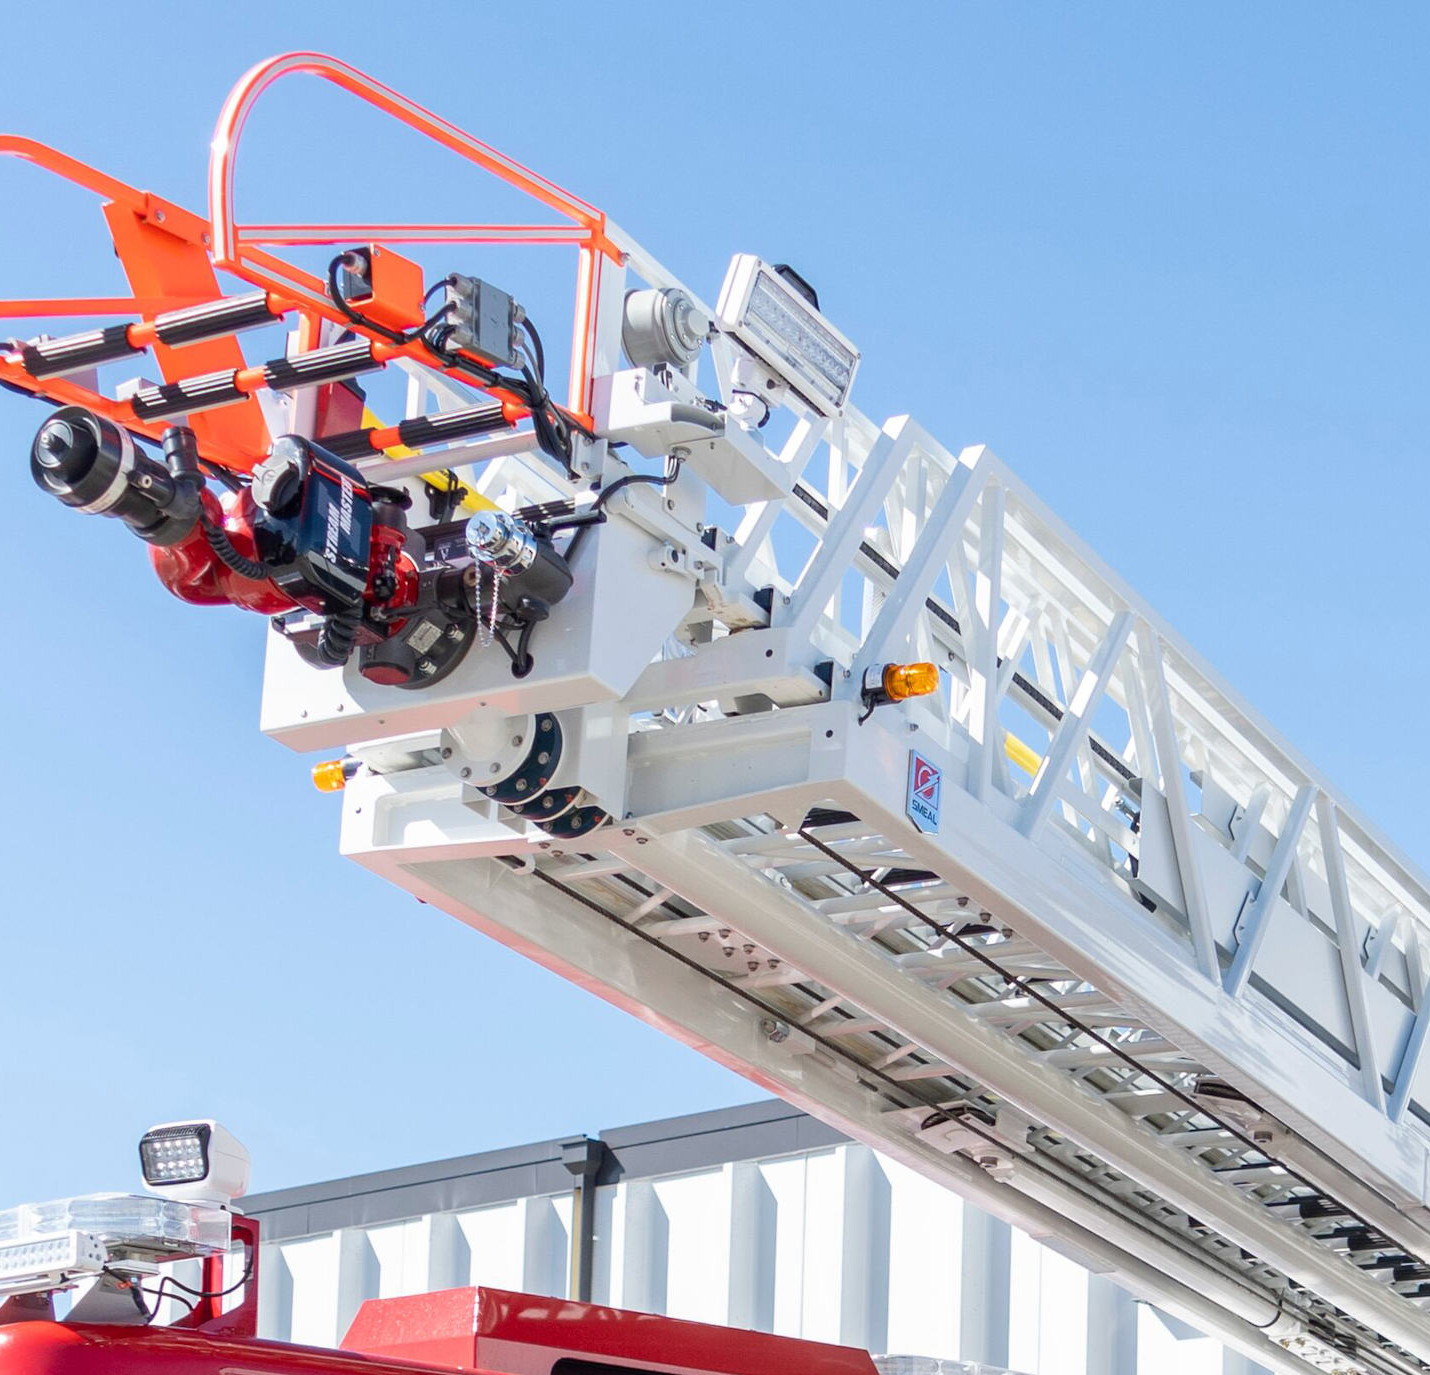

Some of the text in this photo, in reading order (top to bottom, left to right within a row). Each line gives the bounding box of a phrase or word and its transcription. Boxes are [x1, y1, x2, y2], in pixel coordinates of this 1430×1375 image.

[324, 502, 340, 563] STREAM
[340, 475, 354, 535] MASTER
[911, 799, 938, 826] SMEAL
